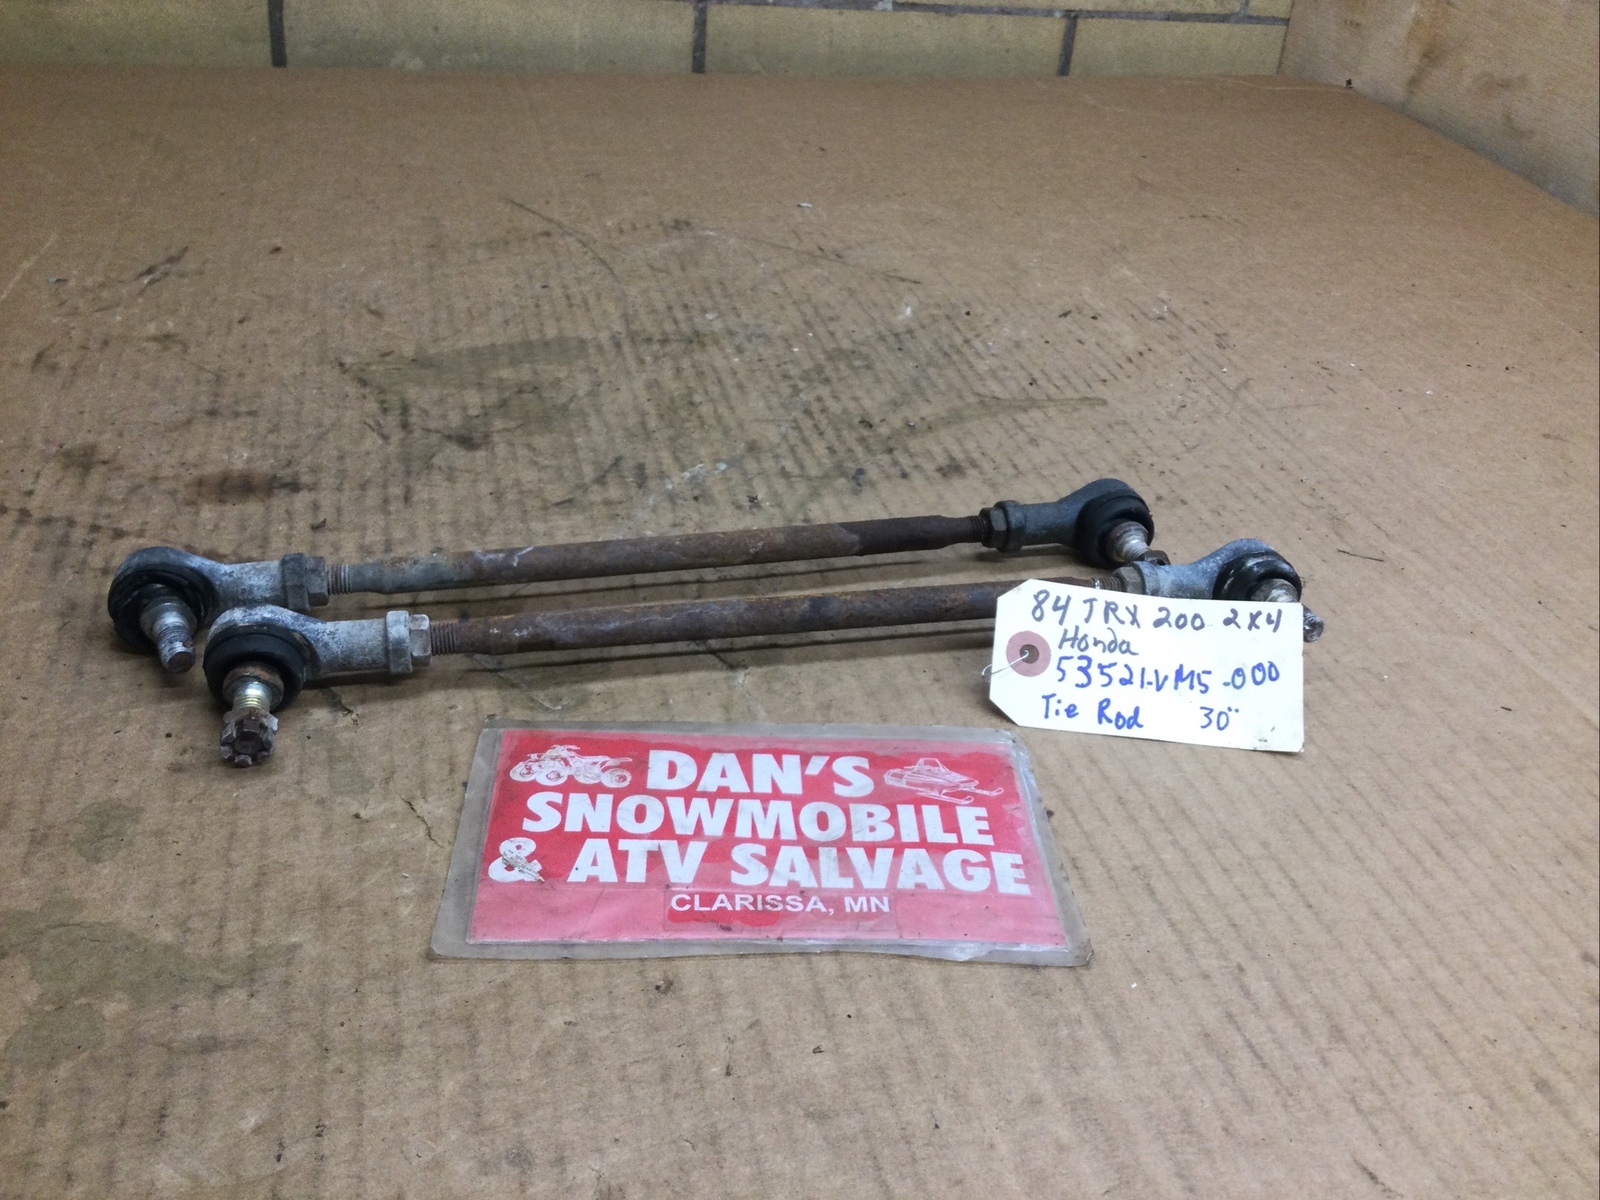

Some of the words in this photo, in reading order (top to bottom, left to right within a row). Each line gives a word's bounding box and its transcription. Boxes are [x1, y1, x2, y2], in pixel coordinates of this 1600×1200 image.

[1031, 589, 1071, 624] 84
[1083, 598, 1141, 628] TRX
[1153, 607, 1205, 631] 200
[1058, 625, 1139, 655] Honda
[1041, 694, 1079, 719] Tie
[1097, 698, 1143, 730] Rod
[646, 749, 871, 797] DAN'S
[522, 792, 995, 846] SNOWMOBILE
[488, 838, 545, 883] &
[567, 839, 706, 884] ATV
[730, 844, 1031, 896] SALVAGE
[671, 893, 835, 916] CLARISSA,
[845, 895, 890, 914] MN
